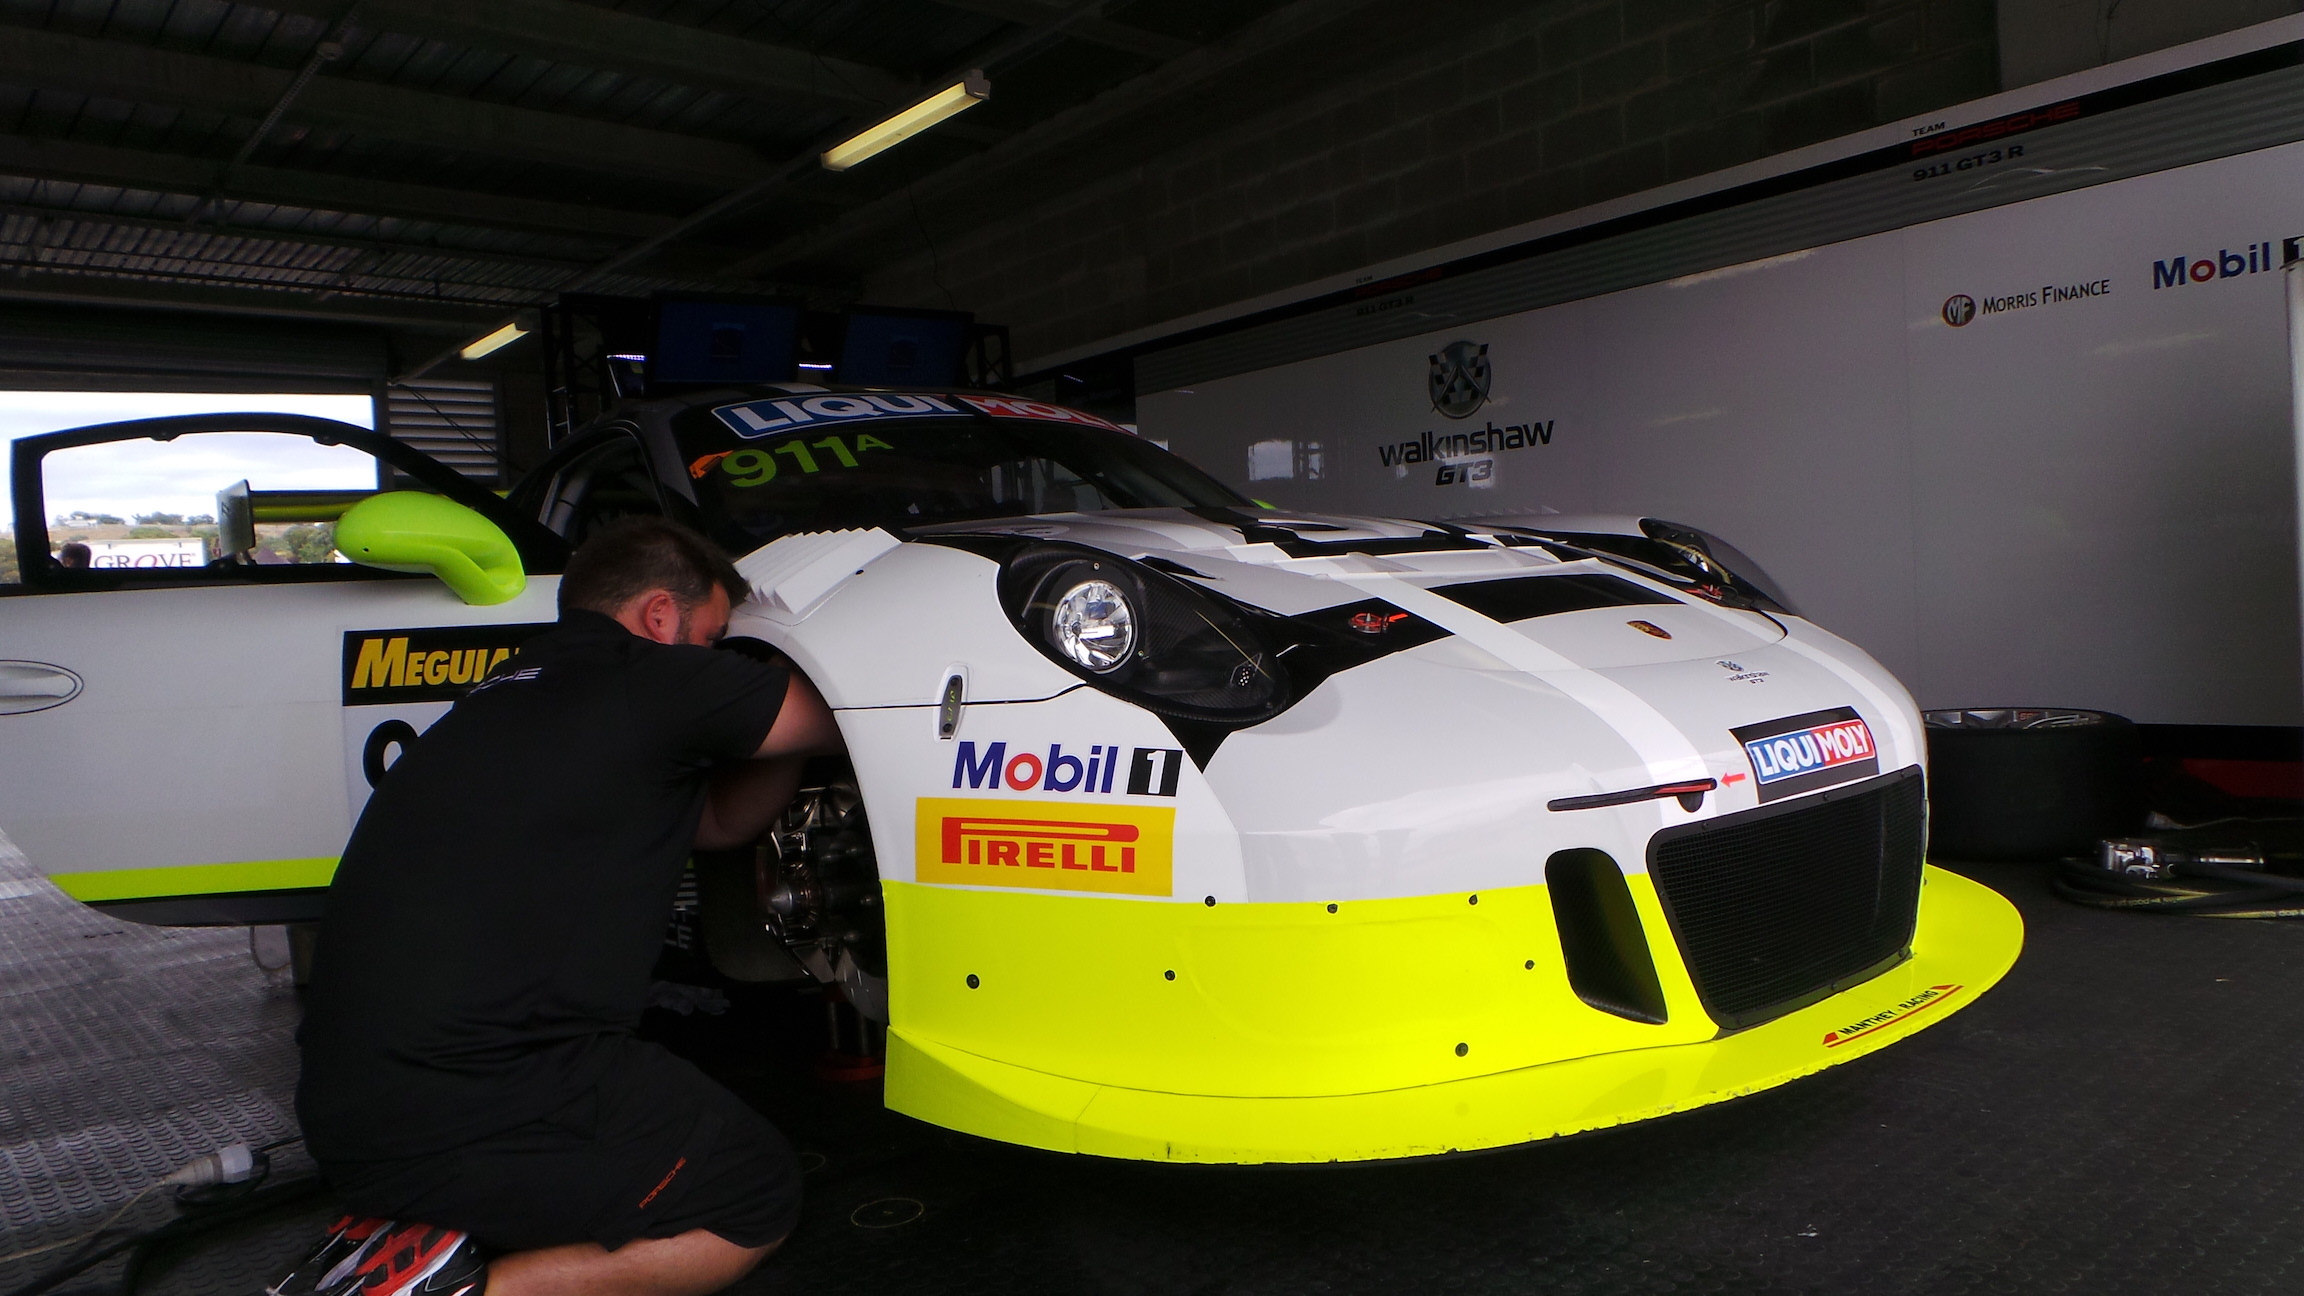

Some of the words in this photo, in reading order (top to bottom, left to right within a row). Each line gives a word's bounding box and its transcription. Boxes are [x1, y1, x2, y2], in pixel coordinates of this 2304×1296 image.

[1911, 101, 2081, 156] PORSCHE
[1913, 122, 1945, 136] TEAM
[1913, 163, 1951, 181] 911
[1957, 150, 2002, 172] GT3
[2008, 145, 2024, 159] R
[2153, 242, 2270, 289] Mobil
[731, 395, 960, 431] LIQUI
[1379, 420, 1554, 467] walkinshaw
[1435, 459, 1493, 485] GT3
[952, 741, 1119, 793] Mobil
[1753, 733, 1821, 777] LIQUI
[1814, 724, 1868, 763] MOLY
[941, 817, 1139, 873] PIRELLI
[1838, 1009, 1897, 1036] MANTHEY
[1898, 989, 1939, 1010] RACING
